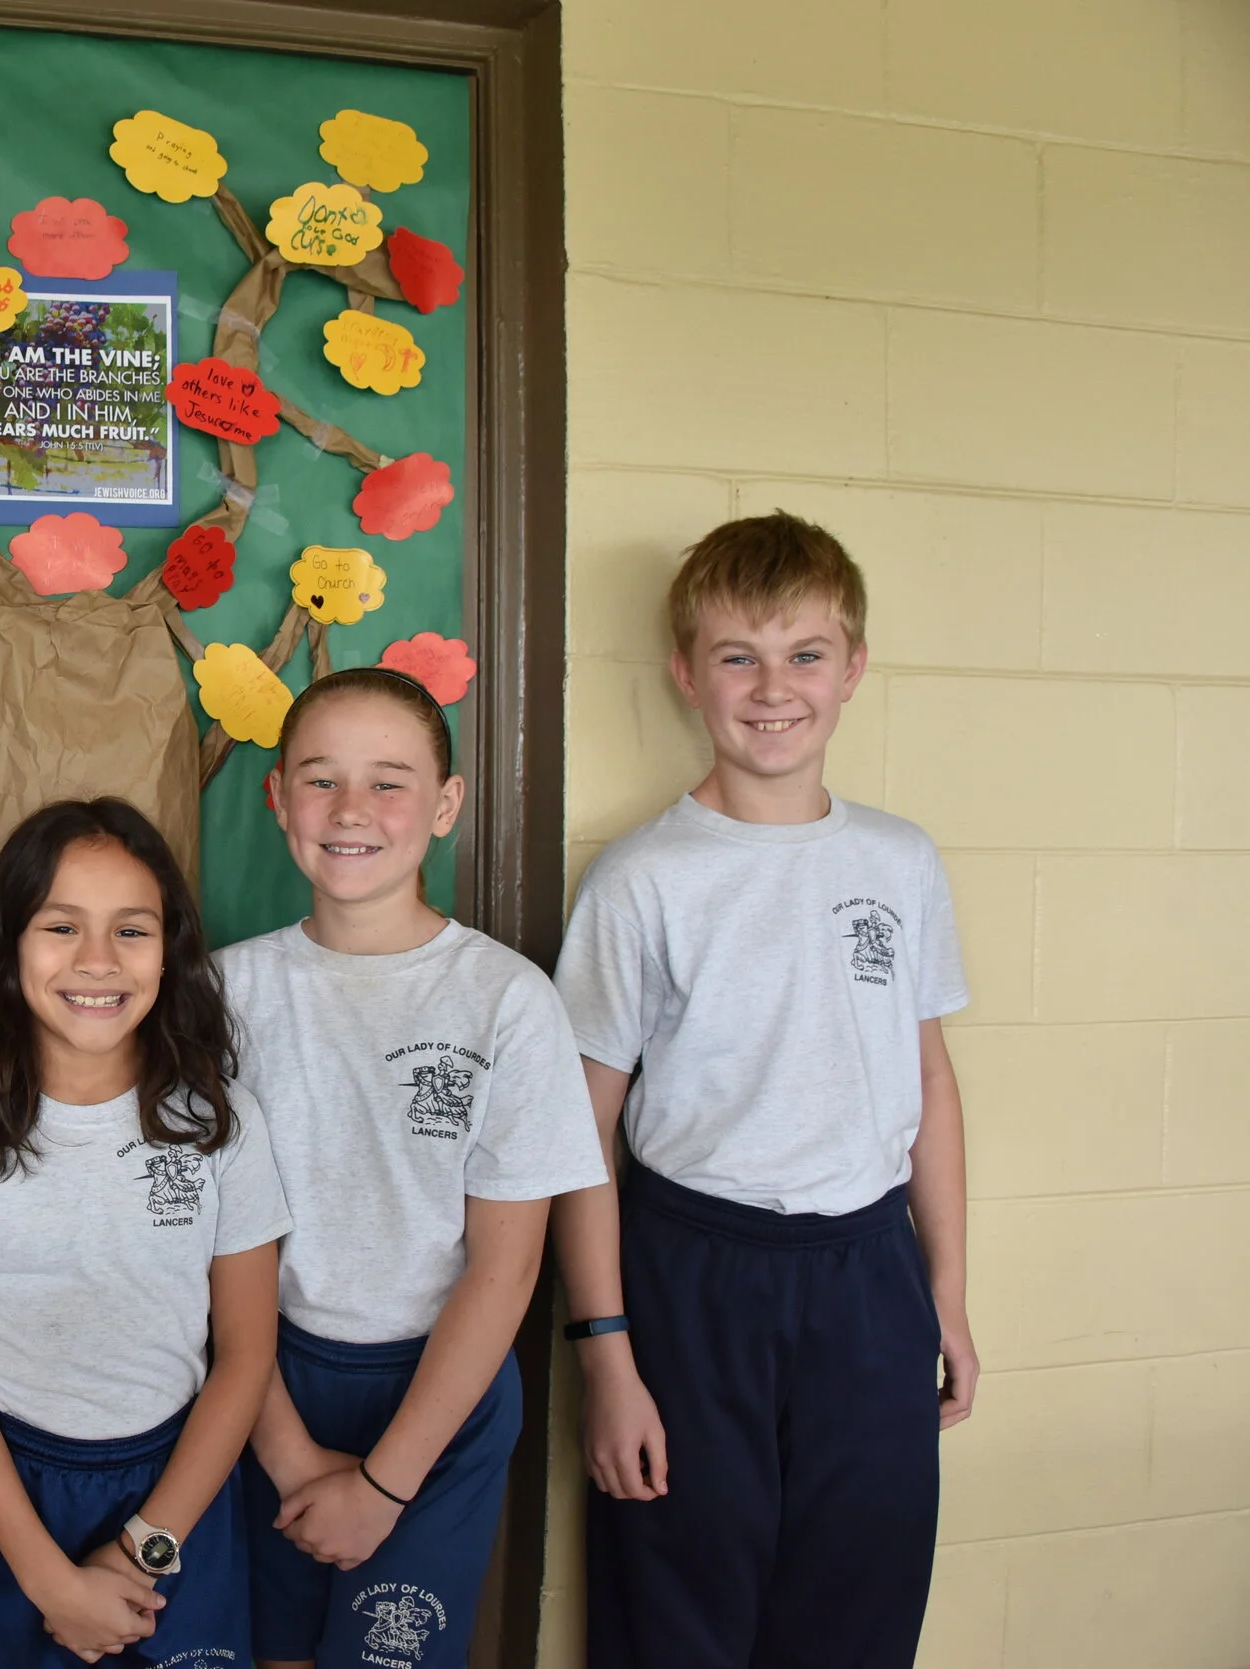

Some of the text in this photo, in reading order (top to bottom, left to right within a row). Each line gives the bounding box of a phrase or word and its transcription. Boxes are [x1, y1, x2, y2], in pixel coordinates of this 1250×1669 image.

[8, 345, 46, 364] AM
[52, 347, 92, 366] THE
[99, 349, 161, 370] VINE;
[14, 367, 44, 381] ARE
[48, 368, 75, 383] THE
[80, 369, 164, 385] BRANCHES.
[207, 368, 234, 389] love
[3, 386, 33, 399] ONE
[36, 387, 73, 400] WHO
[76, 388, 120, 402] ABIDES
[124, 390, 138, 402] IN
[141, 391, 165, 404] ME,
[181, 379, 260, 418] others like
[4, 401, 137, 426] AND I IN HIM,
[42, 423, 94, 439] MUCH
[39, 440, 104, 452] JOHN 15:5 (TLV)
[93, 486, 166, 499] JEWISHVOICE.ORG
[312, 554, 350, 572] Go to
[317, 575, 356, 590] Church
[844, 898, 864, 908] LADY
[865, 898, 877, 906] OF
[854, 973, 887, 986] LANCERS
[385, 1042, 491, 1071] OUR LADY OF LOURDES
[411, 1126, 458, 1140] LANCERS
[116, 1140, 137, 1158] OUR
[152, 1216, 194, 1227] LANCERS
[351, 1583, 447, 1631] OUR LADY OF LOURDES
[361, 1650, 413, 1669] LANCERS
